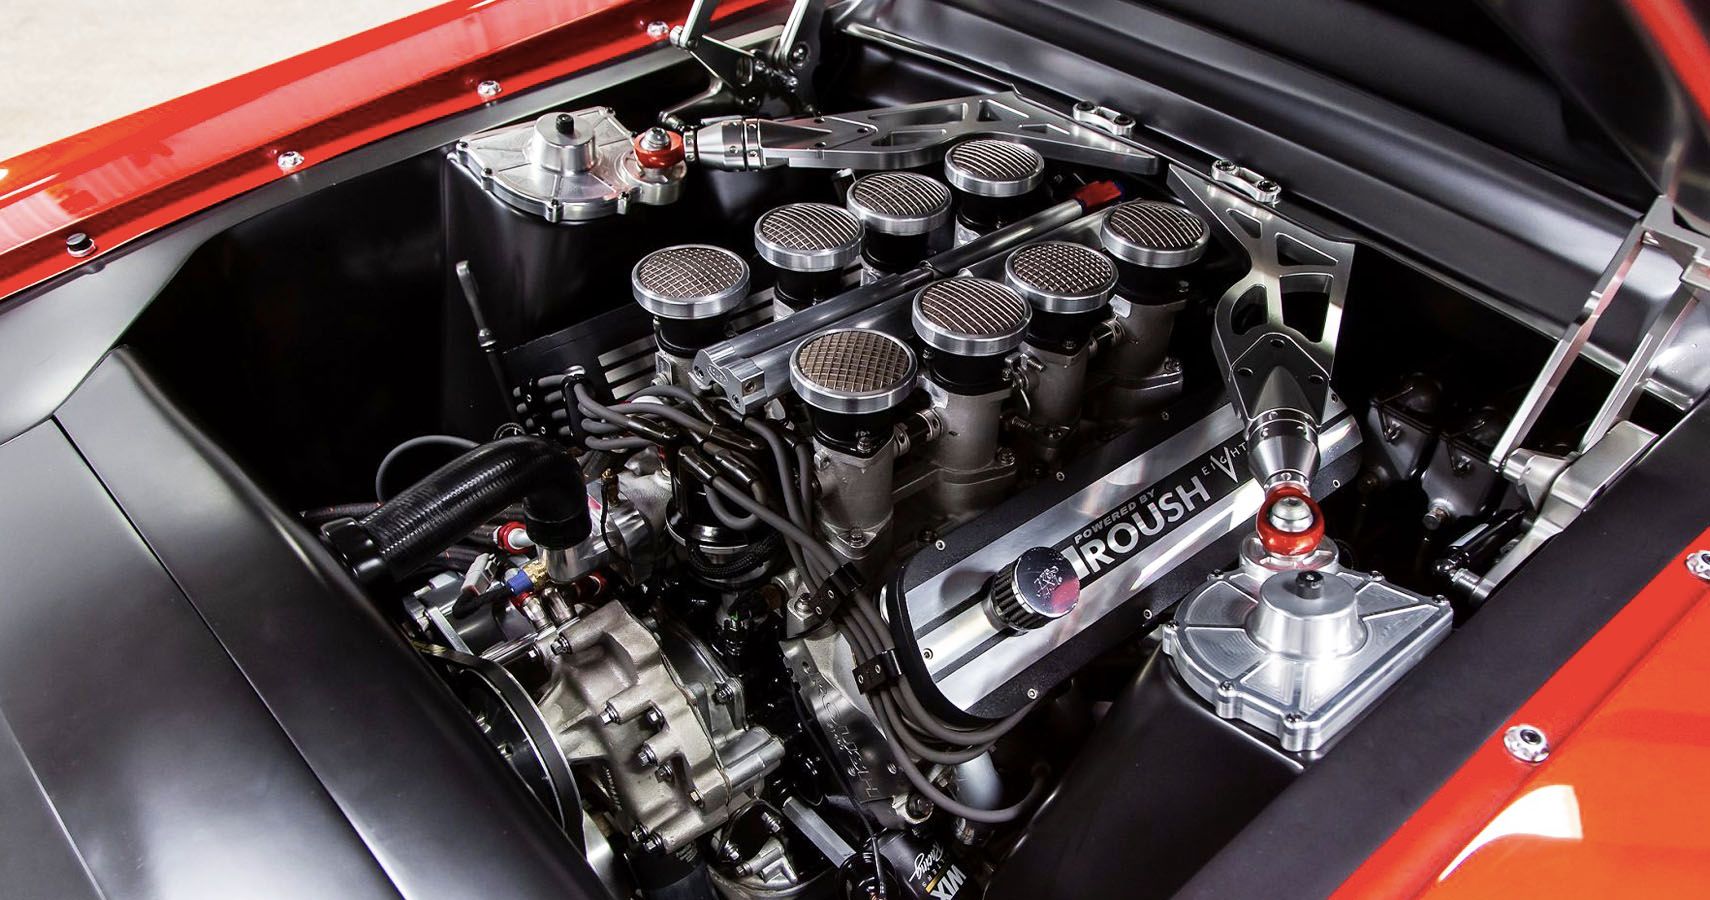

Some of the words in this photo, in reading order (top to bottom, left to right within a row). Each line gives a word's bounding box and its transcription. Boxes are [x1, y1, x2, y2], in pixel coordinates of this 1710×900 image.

[1074, 501, 1137, 545] POWERED
[1139, 488, 1157, 505] BY
[1080, 476, 1211, 573] ROUSH
[909, 841, 944, 882] Racing
[930, 864, 967, 900] WIX
